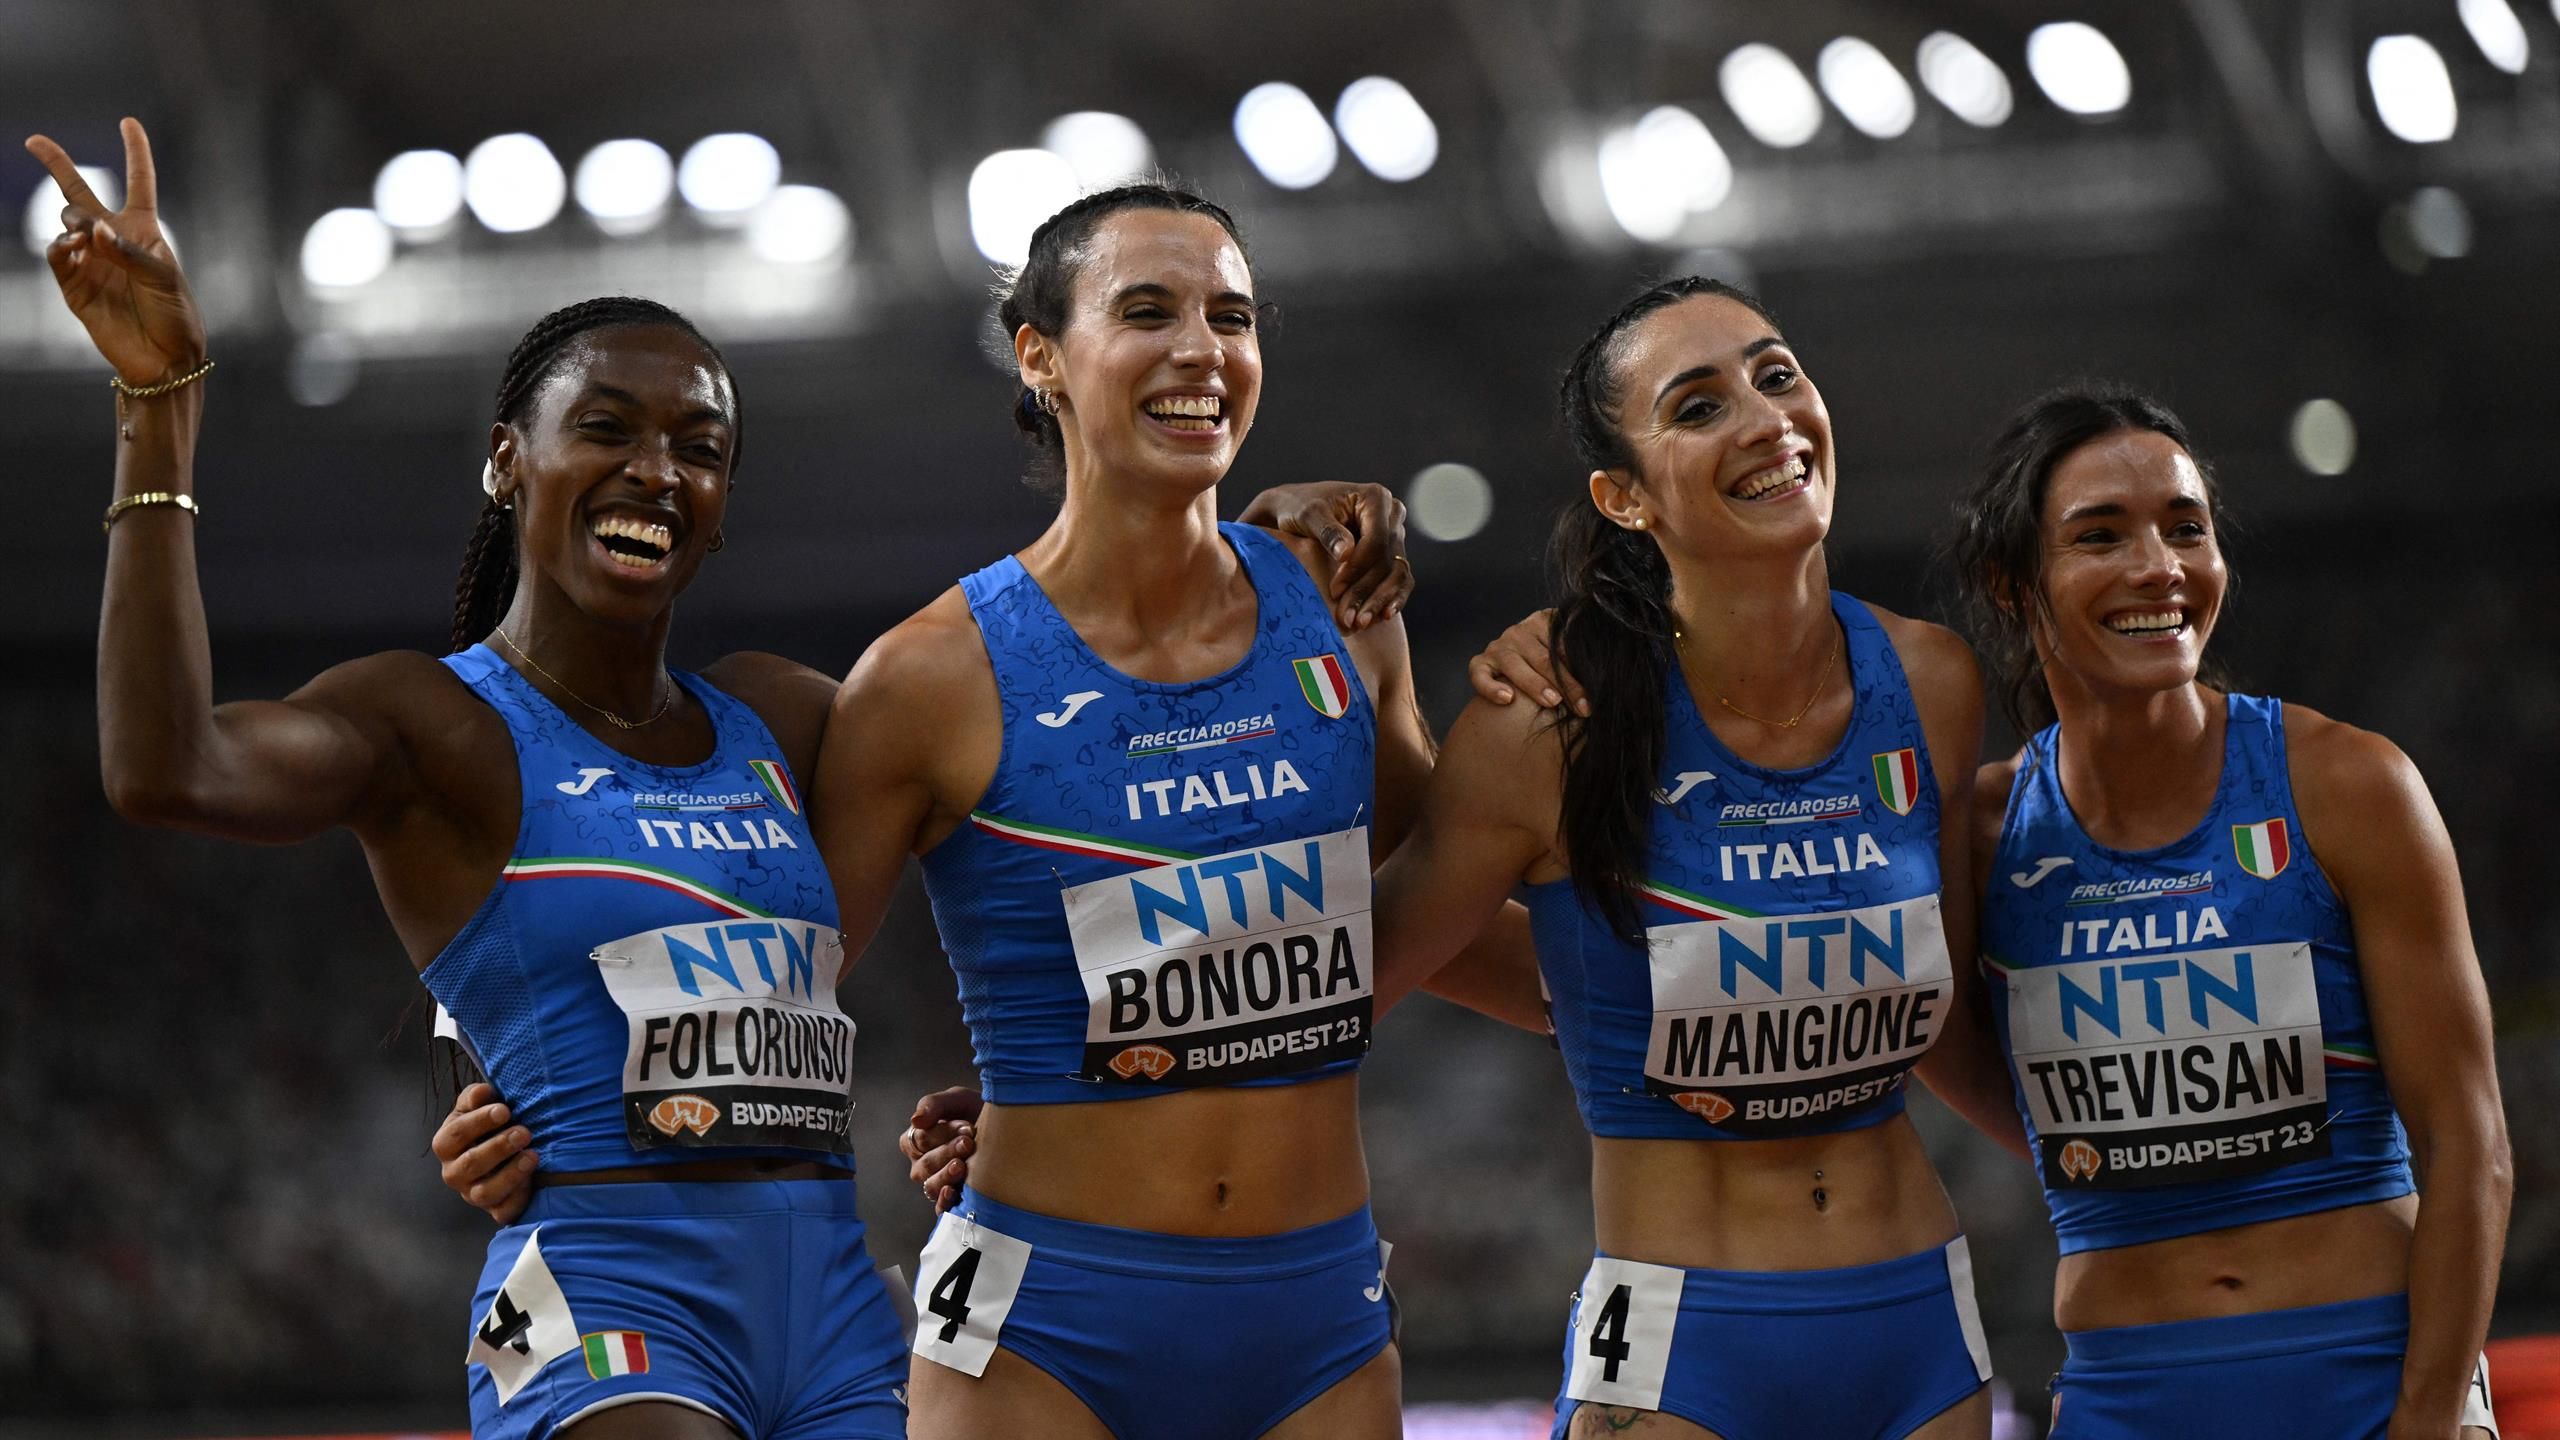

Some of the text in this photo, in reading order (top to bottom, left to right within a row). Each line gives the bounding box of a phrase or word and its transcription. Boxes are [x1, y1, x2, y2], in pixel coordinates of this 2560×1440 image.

[1128, 714, 1275, 751] FRECCIAROSSA
[634, 791, 764, 806] FRECCIAROSSA
[1126, 759, 1310, 820] ITALIA
[1720, 794, 1860, 819] FRECCIAROSSA
[637, 818, 799, 850] ITALIA
[1720, 832, 1890, 881] ITALIA
[1130, 841, 1325, 947] NTN
[2071, 870, 2213, 899] FRECCIAROSSA
[1718, 908, 1906, 1000] NTN
[2060, 906, 2229, 956] ITALIA
[662, 922, 817, 1005] NTN
[1106, 926, 1361, 1034] BONORA
[2058, 952, 2259, 1044] NTN
[639, 1006, 849, 1085] FOLORUNSO
[1187, 1016, 1361, 1071] BUDAPEST 23
[1664, 988, 1940, 1078] MANGIONE
[1745, 1067, 1912, 1122] BUDAPEST 2
[2027, 1035, 2305, 1124] TREVISAN
[731, 1101, 833, 1132] BUDAPEST
[2109, 1120, 2315, 1171] BUDAPEST 23
[928, 1247, 983, 1344] 4
[1589, 1283, 1633, 1384] 4
